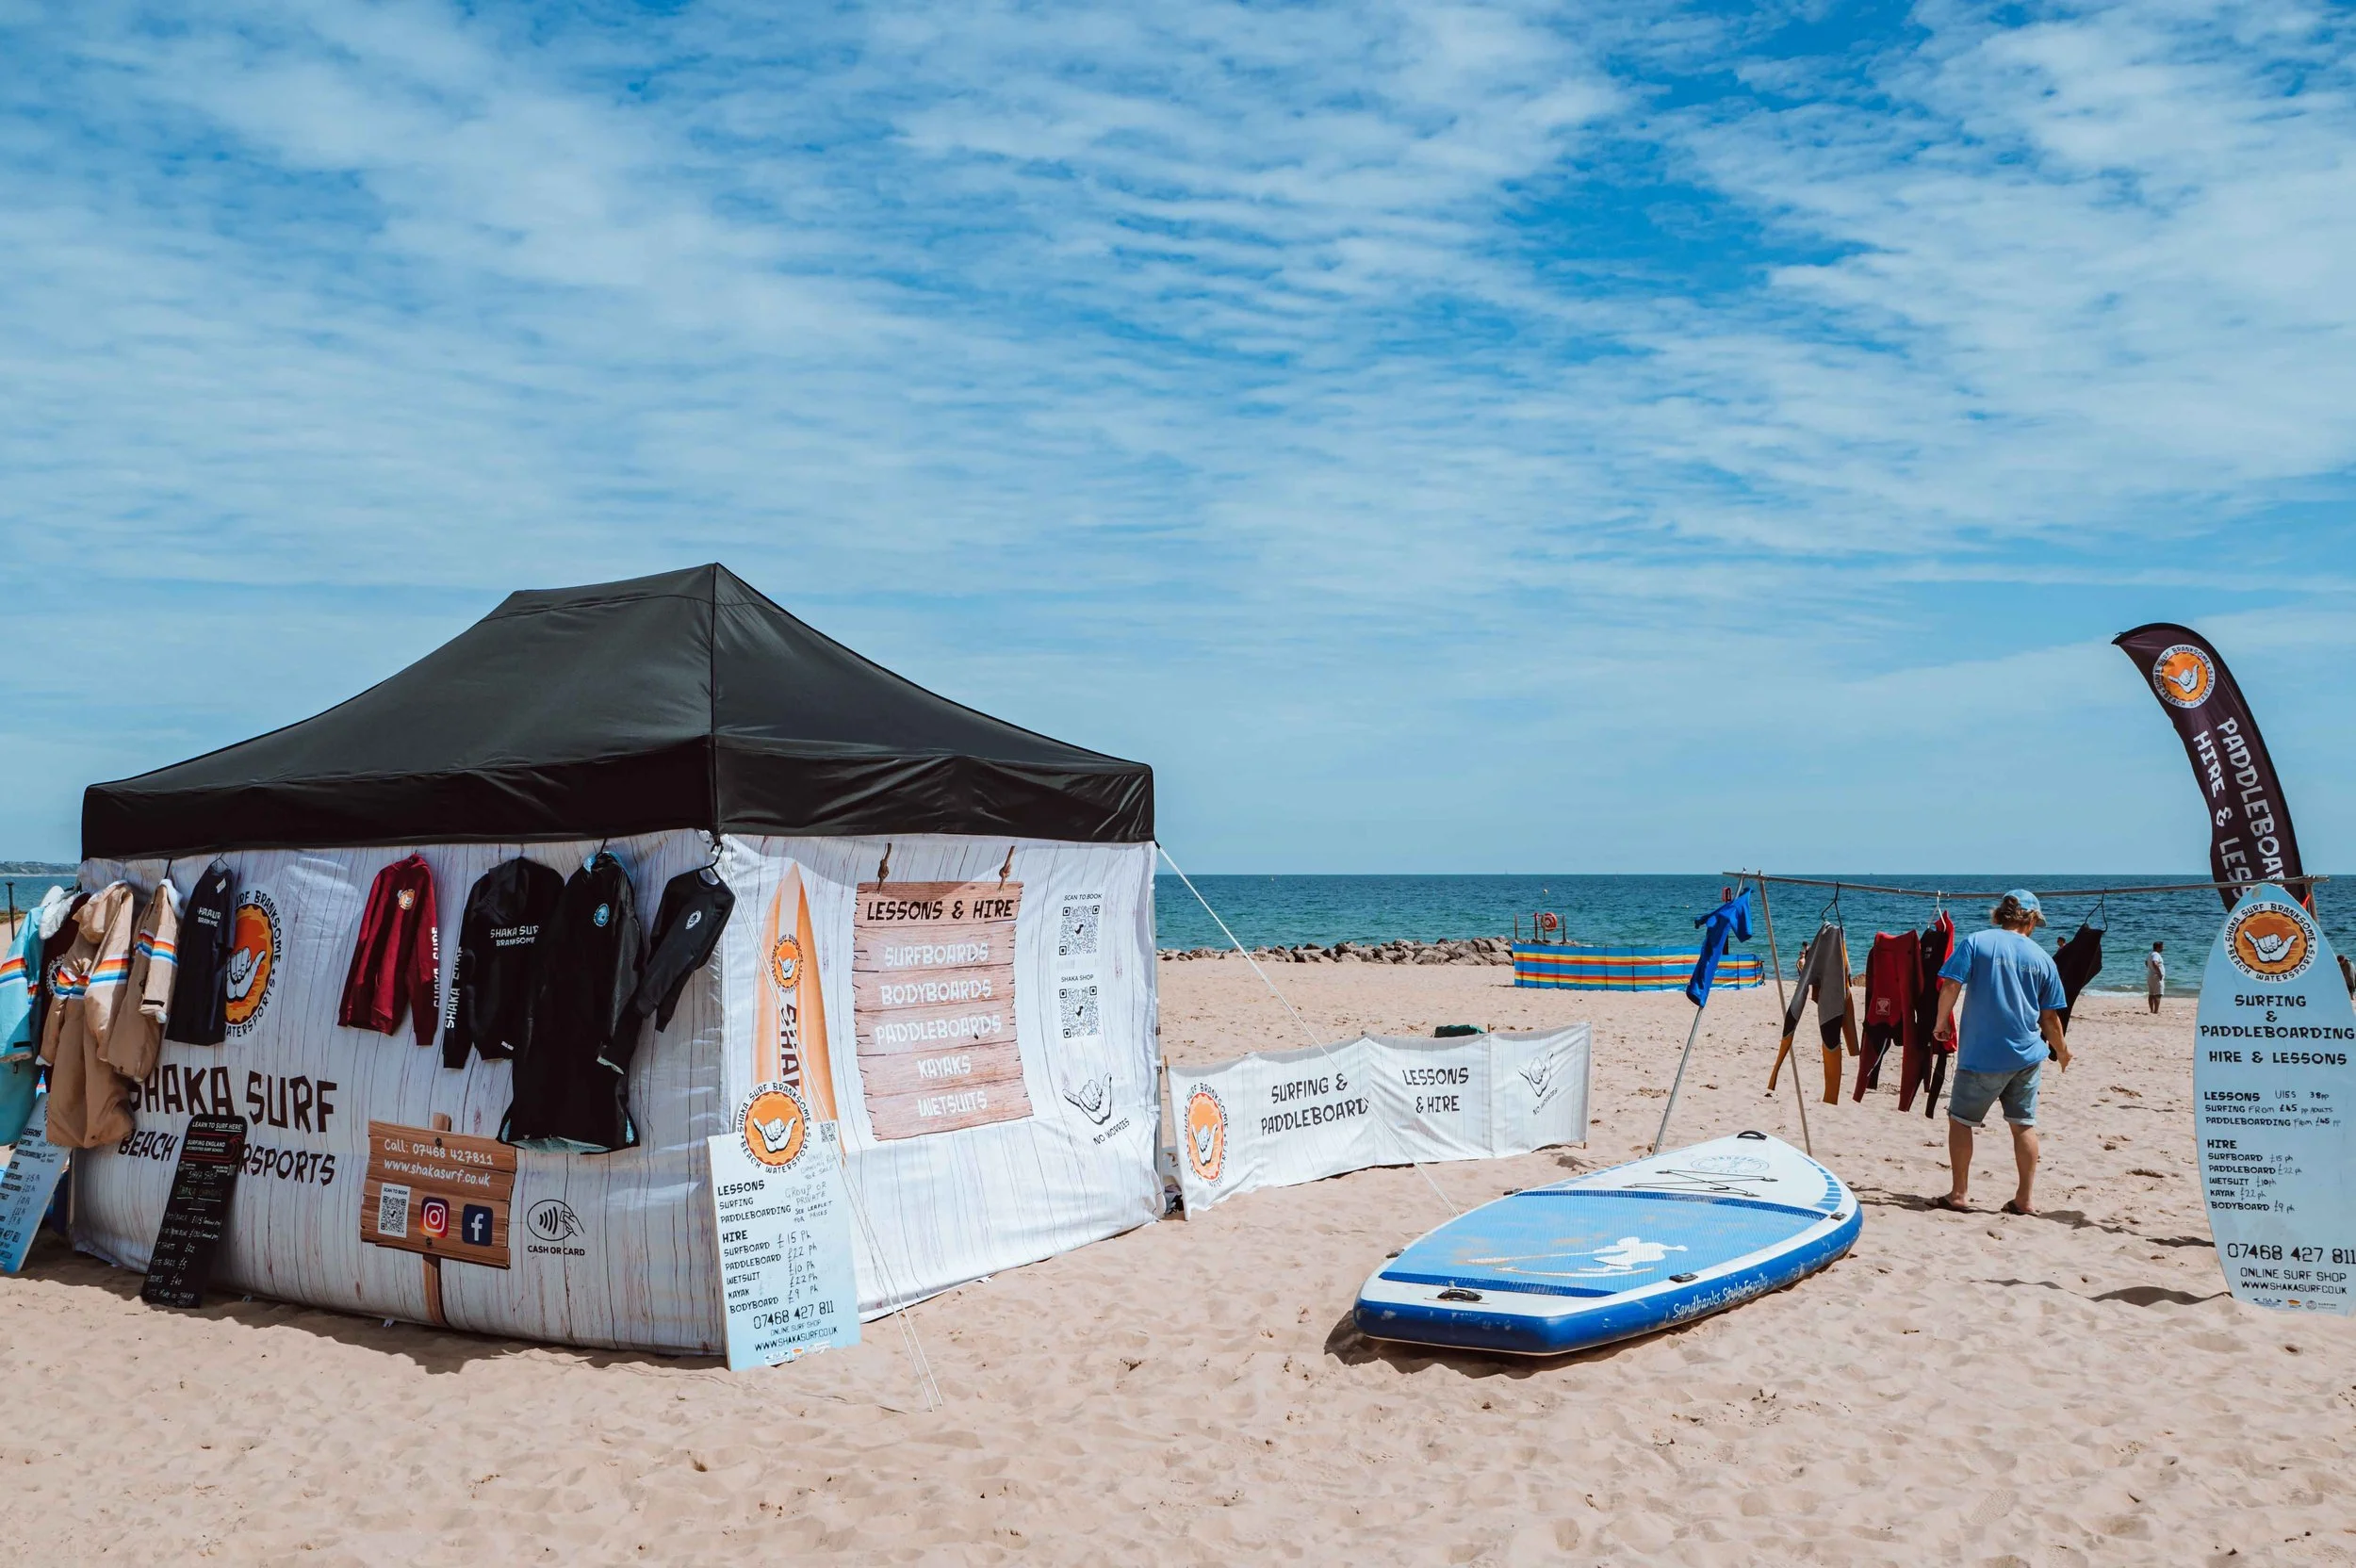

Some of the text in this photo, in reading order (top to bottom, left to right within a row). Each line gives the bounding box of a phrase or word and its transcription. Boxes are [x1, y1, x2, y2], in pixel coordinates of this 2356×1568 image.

[2172, 645, 2211, 664] BRANKSOME
[2193, 730, 2225, 798] HIRE
[867, 899, 1015, 921] LESSONS & HIRE
[254, 890, 282, 964] BRANKSOME
[2225, 903, 2316, 941] SHAKA SURF BRANKSOME
[490, 927, 518, 939] SHAKA
[884, 942, 989, 967] SURFBOARDS
[2228, 949, 2315, 982] BEACH WATERSPORTS
[880, 979, 992, 1005] BODYBOARDS
[2234, 995, 2306, 1007] SURFING
[225, 978, 276, 1037] ATERSPORTS
[445, 988, 461, 1029] SHAKA
[2266, 1010, 2278, 1022] &
[875, 1014, 1003, 1046] PADDLEBOARDS
[2200, 1025, 2355, 1039] PADDLEBOARDING
[917, 1054, 972, 1079] KAYAKS
[2209, 1051, 2348, 1066] HIRE & LESSONS
[1402, 1067, 1469, 1086] LESSONS
[1271, 1072, 1349, 1104] SURFING &
[2204, 1091, 2260, 1102] LESSONS
[246, 1070, 337, 1135] SURF
[737, 1082, 811, 1132] SHAKA SURF BRANKSOME
[917, 1090, 988, 1117] WETSUITS
[1415, 1095, 1461, 1114] & HIRE
[2205, 1104, 2245, 1113] SURFING
[2280, 1103, 2298, 1113] £45
[2205, 1117, 2291, 1127] PADDLEBOARDING
[2315, 1117, 2331, 1127] £45
[118, 1131, 179, 1162] BEACH
[1093, 1134, 1105, 1145] NO
[2207, 1139, 2237, 1150] HIRE
[384, 1138, 494, 1166] Call: 07468 427811
[740, 1140, 761, 1168] BEACH
[765, 1132, 812, 1174] WATERSPORTS
[2208, 1152, 2264, 1162] SURFBOARD
[384, 1159, 491, 1187] www.shakasurf.co.uk
[2209, 1165, 2276, 1174] PADDLEBOARD
[717, 1180, 765, 1196] LESSONS
[2209, 1177, 2250, 1185] WETSUIT
[785, 1184, 811, 1199] GROUP
[795, 1191, 826, 1206] PRIVATE
[719, 1197, 754, 1210] SURFING
[794, 1200, 834, 1216] SEE LEAFLET
[2210, 1201, 2270, 1212] BODYBOARD
[720, 1205, 792, 1224] PADDLEBOARDING
[810, 1210, 827, 1218] PRICES
[722, 1230, 748, 1243] HIRE
[528, 1245, 585, 1256] CASH OR CARD
[724, 1241, 771, 1257] SURFBOARD
[2227, 1243, 2356, 1265] 07468 427 811
[725, 1253, 782, 1271] PADDLEBOARD
[727, 1271, 761, 1285] WETSUIT
[2240, 1266, 2347, 1282] ONLINE SURF SHOP
[728, 1288, 750, 1299] KAYAK
[729, 1296, 779, 1315] BODYBOARD
[1673, 1290, 1721, 1319] Sandbanks
[753, 1299, 835, 1330] 07468 427 811
[770, 1318, 822, 1336] ONLINE SURF SHOP
